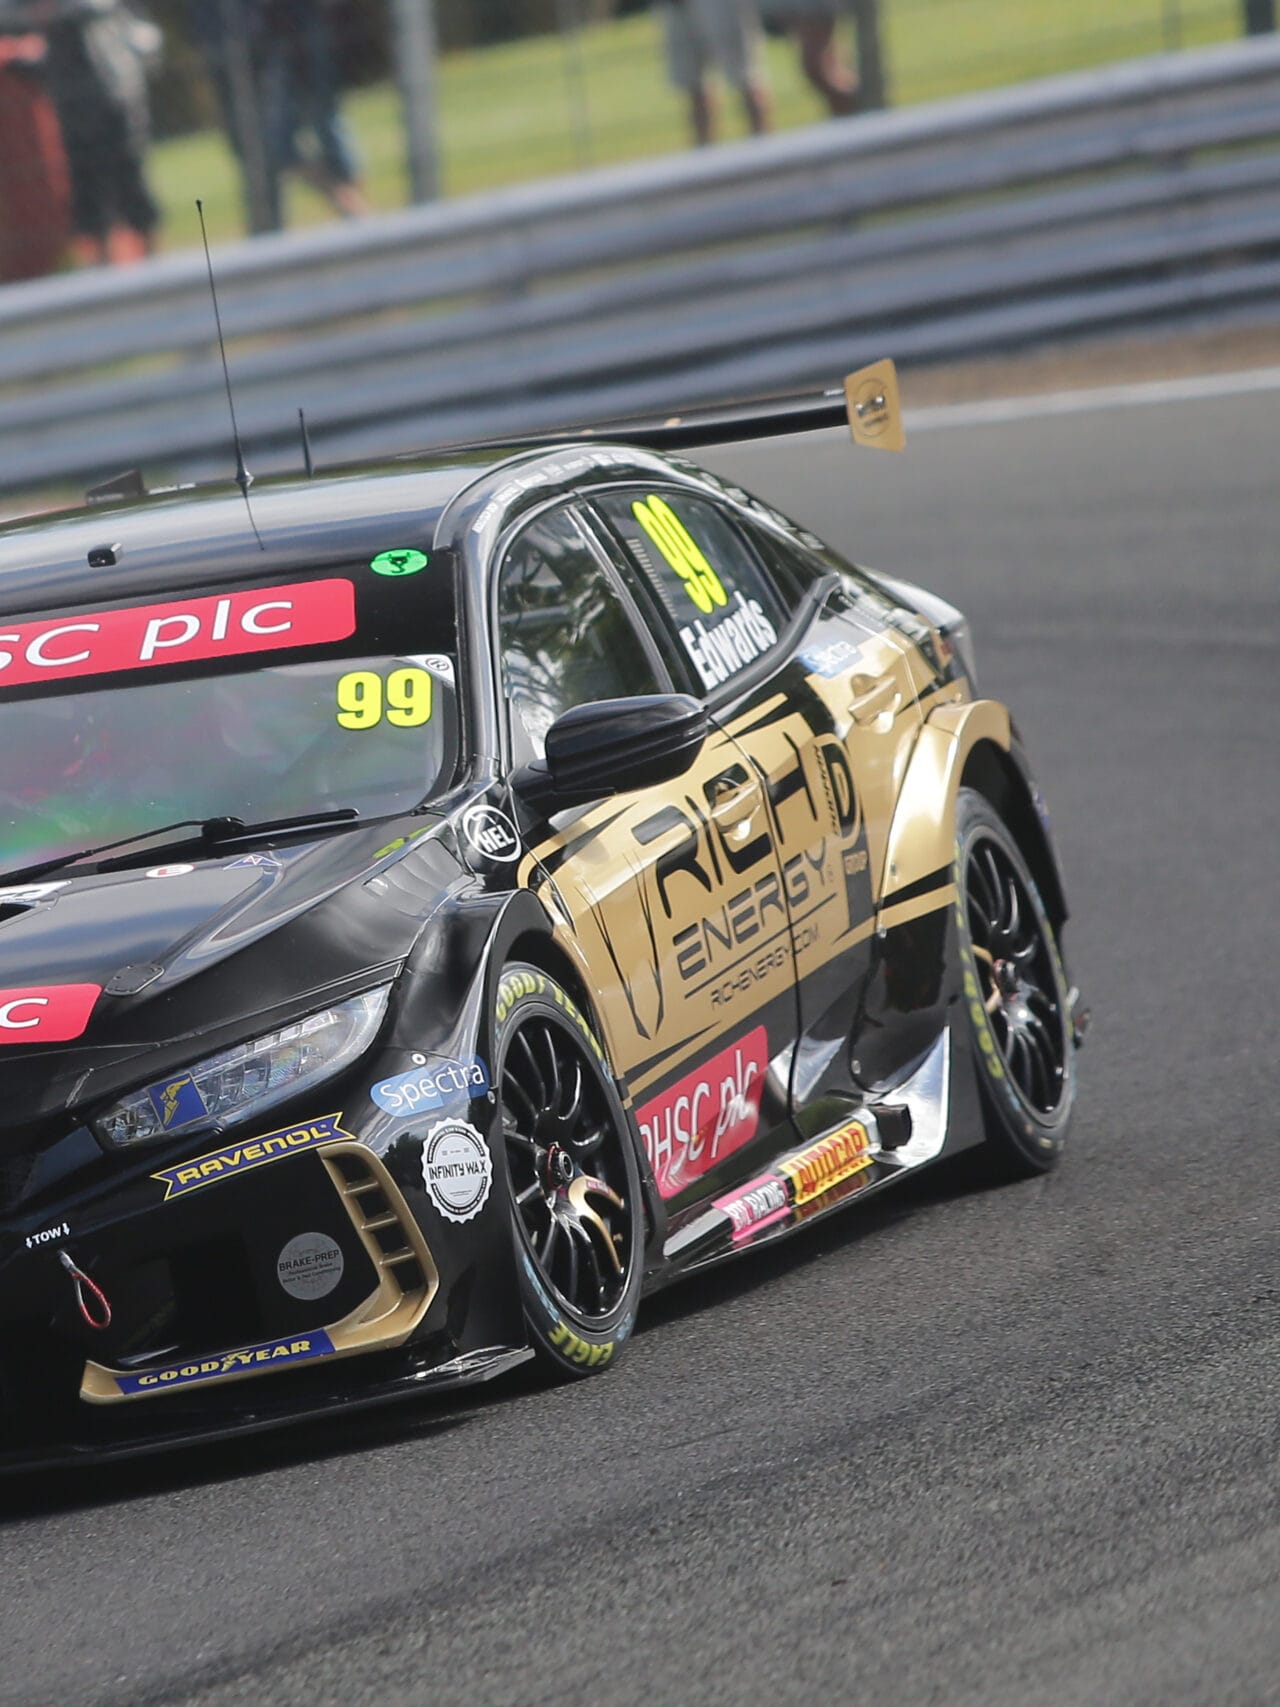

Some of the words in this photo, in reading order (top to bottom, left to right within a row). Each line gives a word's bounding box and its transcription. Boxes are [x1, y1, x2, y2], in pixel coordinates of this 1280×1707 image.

[632, 494, 728, 615] 99
[138, 599, 293, 660] plc
[678, 590, 778, 691] Edwards
[335, 667, 433, 732] 99
[478, 825, 516, 854] HEL
[672, 837, 827, 981] ENERGY
[380, 1064, 485, 1110] Spectra
[175, 1126, 332, 1185] RAVENOL
[428, 1162, 465, 1180] INFINITY
[465, 1160, 487, 1175] WAX
[32, 1226, 61, 1245] TOW
[279, 1250, 340, 1271] BRAKE-PREP
[138, 1340, 311, 1386] GOODYEAR
[547, 1319, 615, 1367] EAGLE
